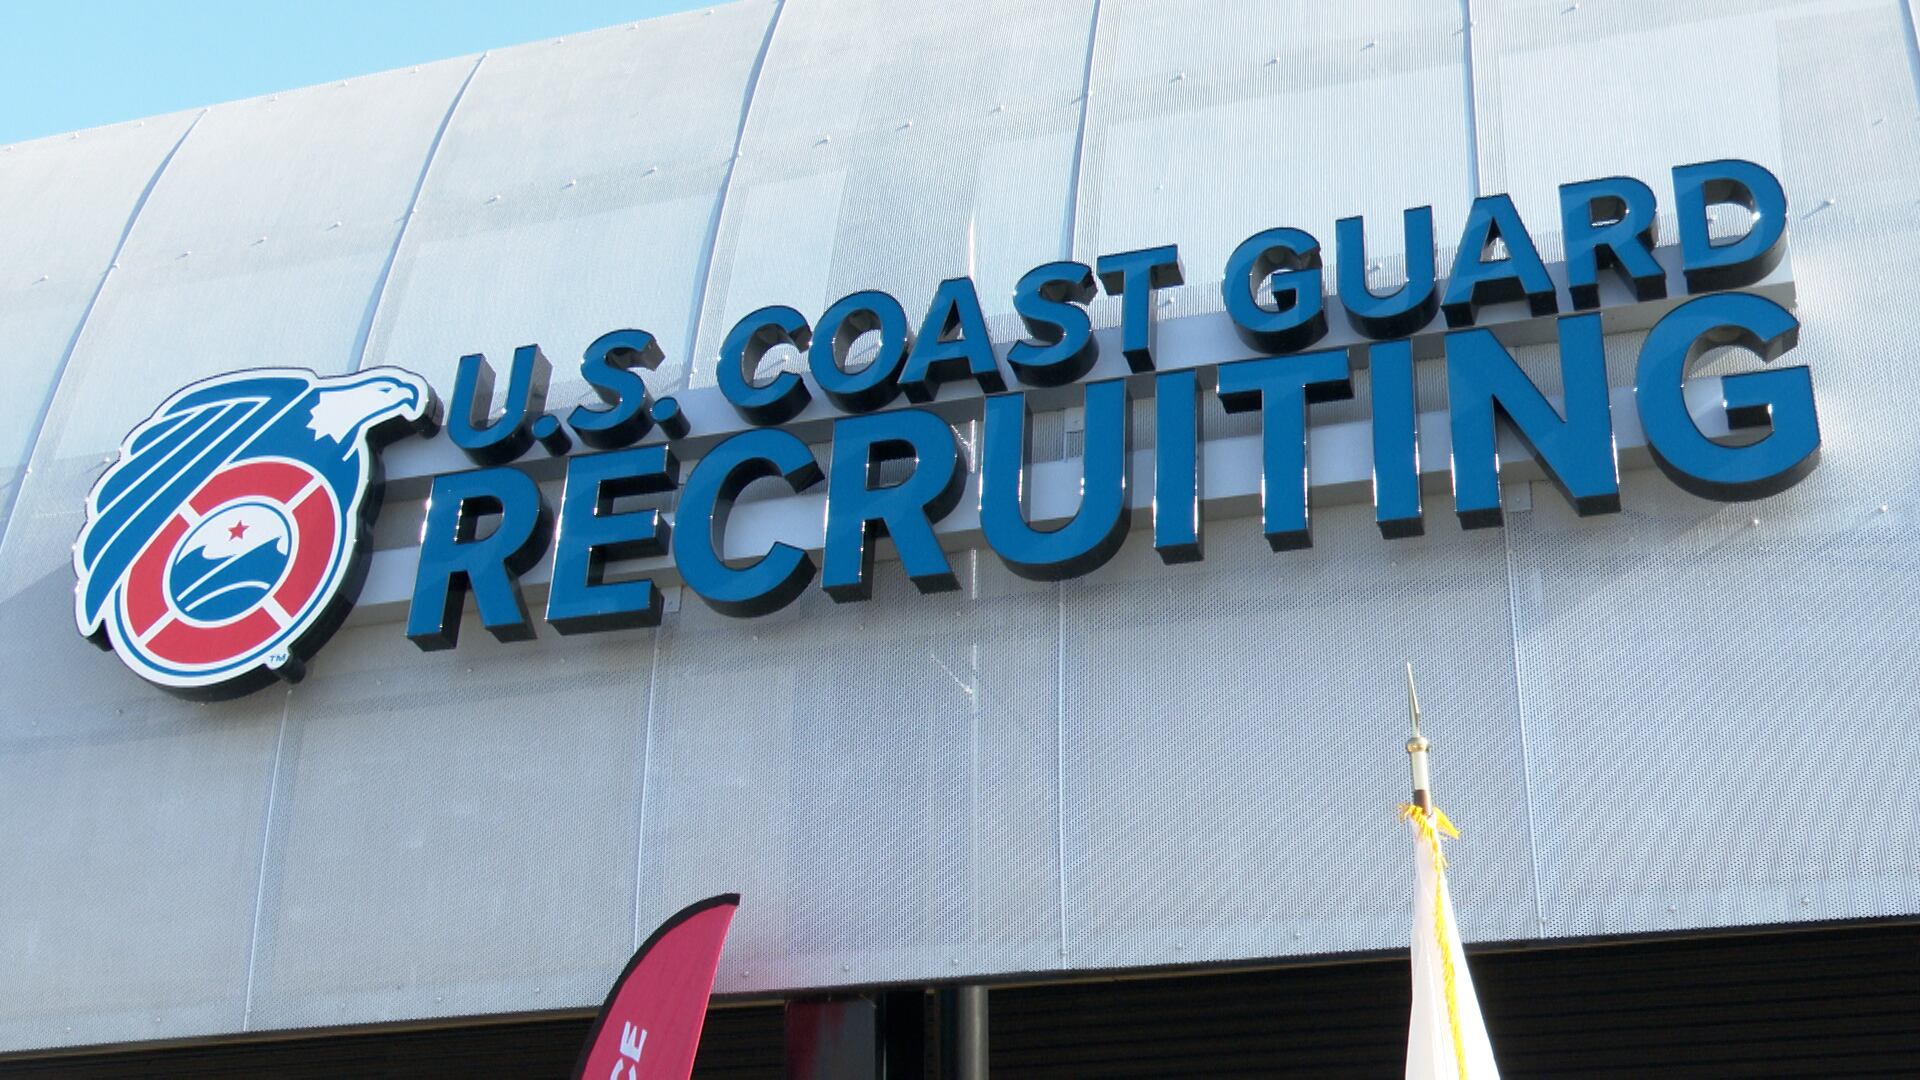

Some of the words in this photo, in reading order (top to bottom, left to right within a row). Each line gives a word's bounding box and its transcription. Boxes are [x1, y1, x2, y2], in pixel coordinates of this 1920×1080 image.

[447, 328, 687, 458] U.S.
[716, 245, 1182, 414] COAST
[1222, 159, 1788, 345] GUARD
[406, 292, 1822, 646] RECRUITING
[269, 653, 287, 662] TM
